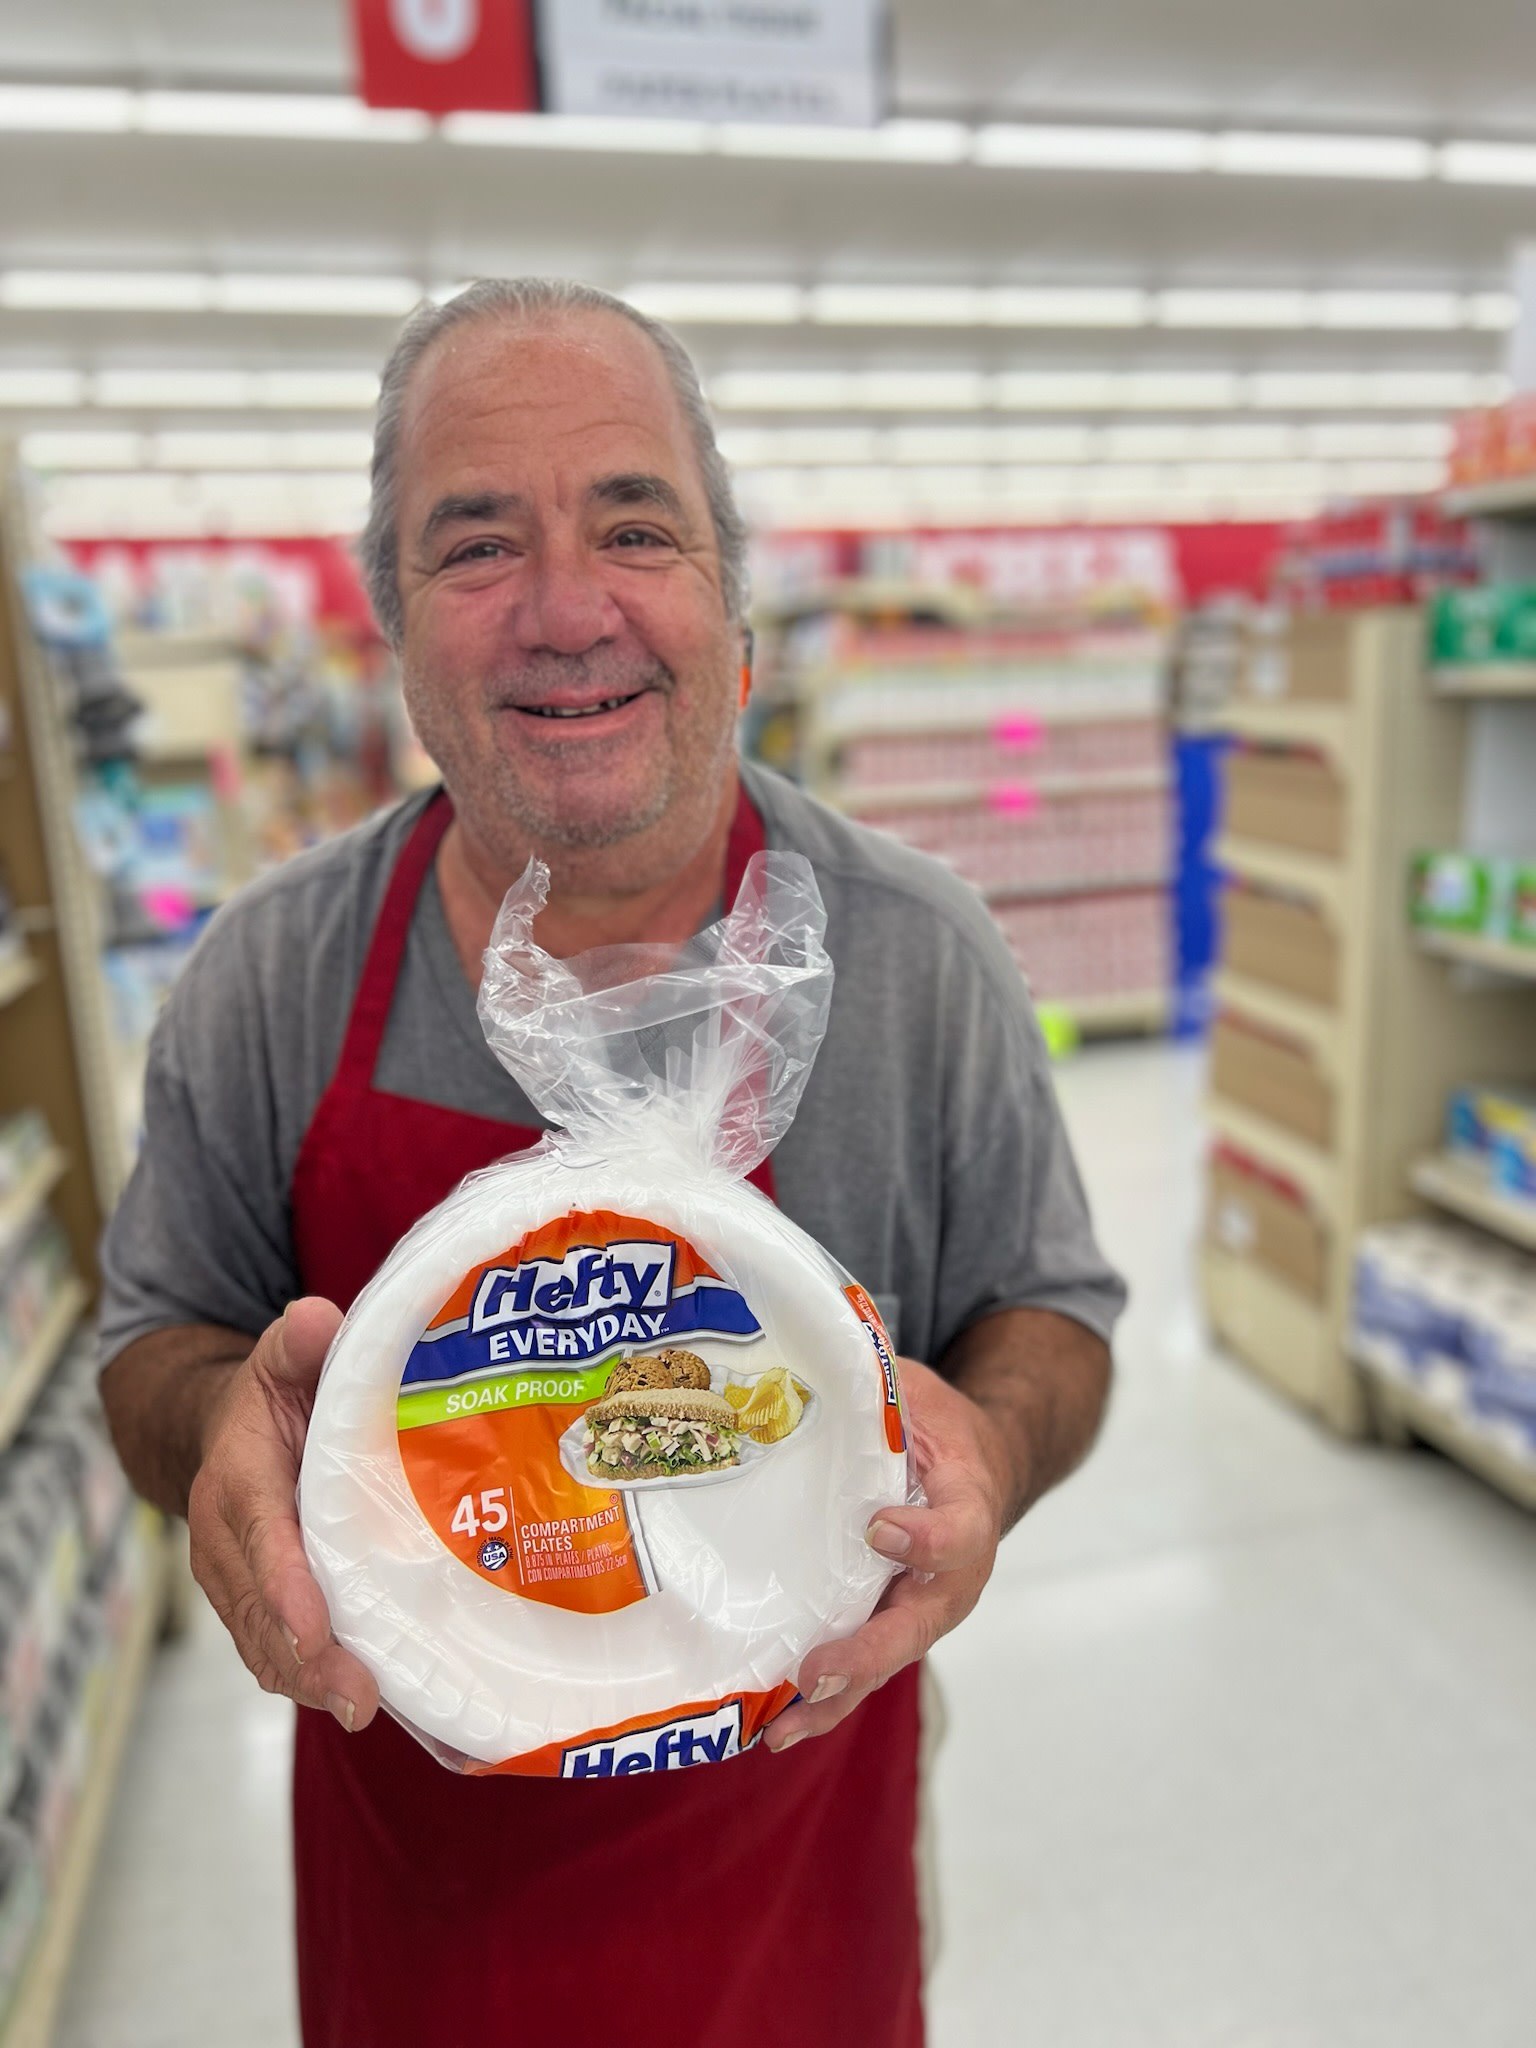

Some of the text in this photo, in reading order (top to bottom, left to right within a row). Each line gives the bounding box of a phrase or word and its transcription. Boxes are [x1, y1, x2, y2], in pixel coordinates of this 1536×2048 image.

[482, 1253, 666, 1319] Hefty
[489, 1312, 668, 1361] EVERYDAY
[446, 1379, 585, 1414] SOAK PROOF
[451, 1487, 509, 1538] 45
[520, 1505, 621, 1539] COMPARTMENT
[484, 1551, 506, 1563] USA
[523, 1535, 573, 1554] PLATES
[556, 1550, 580, 1566] PLATES
[586, 1542, 612, 1562] PLATOS
[527, 1567, 543, 1584] CON
[543, 1561, 606, 1581] COMPARTIMENTOS
[572, 1723, 735, 1779] Hefty
